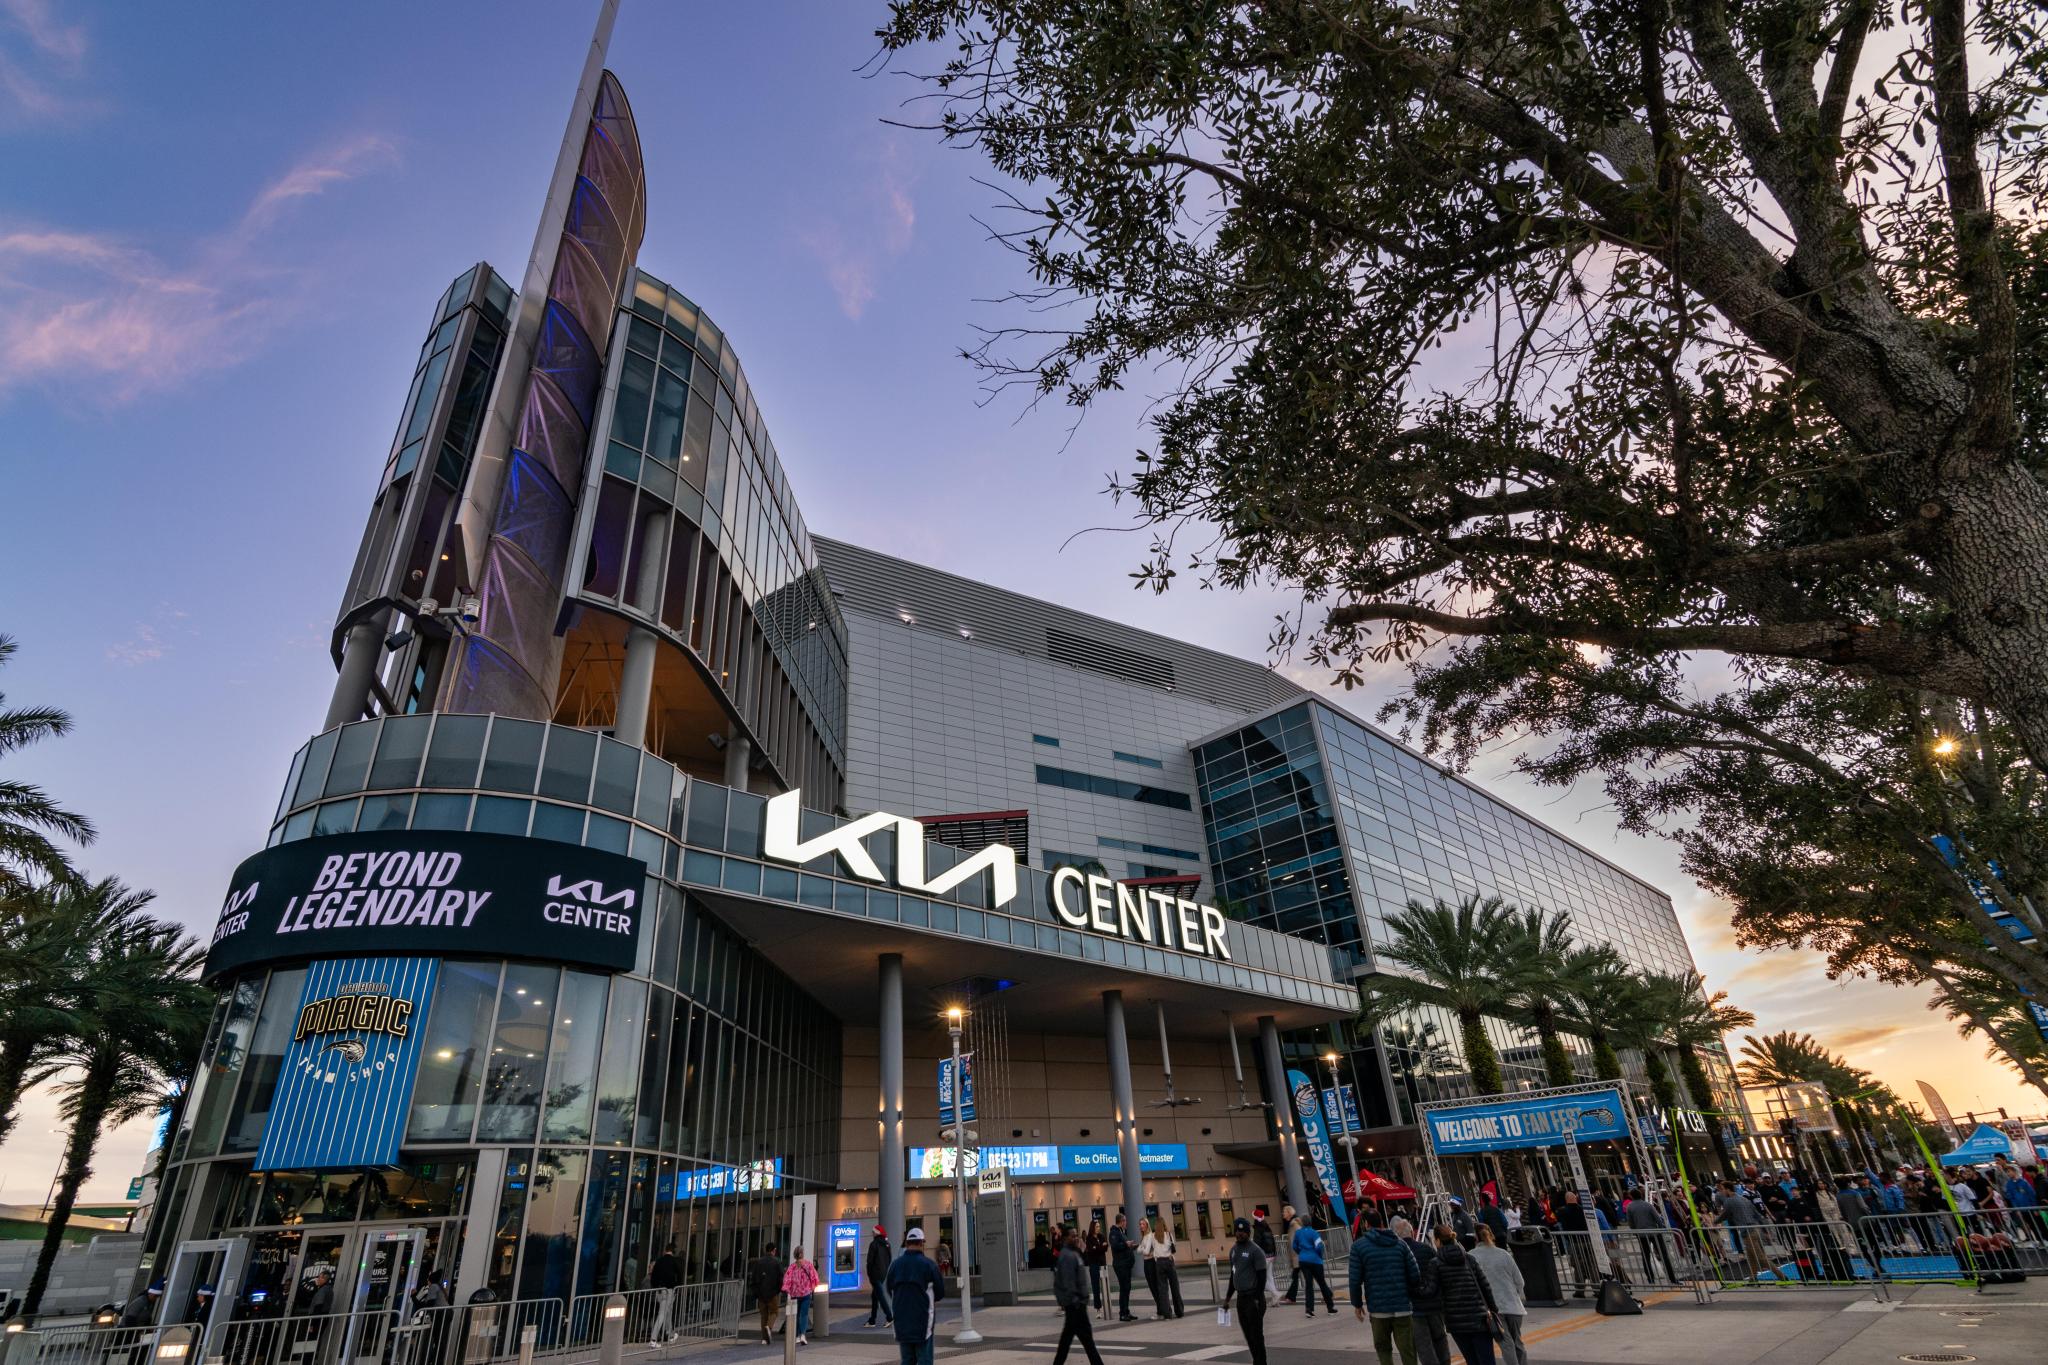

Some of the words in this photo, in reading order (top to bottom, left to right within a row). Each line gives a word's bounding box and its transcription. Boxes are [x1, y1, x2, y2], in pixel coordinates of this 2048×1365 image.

[312, 851, 462, 892] BEYOND
[764, 787, 1017, 909] KIA
[1052, 866, 1231, 960] CENTER
[547, 874, 635, 909] KIA
[276, 889, 493, 935] LEGENDARY
[543, 901, 631, 935] CENTER
[294, 994, 413, 1042] MAGIC
[298, 1056, 336, 1084] TEAM
[350, 1052, 396, 1082] SHOP
[943, 1063, 952, 1104] MAGIC
[1434, 1116, 1502, 1143] WELCOME
[1500, 1114, 1523, 1137] TO
[1522, 1111, 1552, 1136] FAN
[988, 1152, 1008, 1169] DEC
[1008, 1152, 1021, 1169] 23
[1025, 1152, 1031, 1168] 7
[1032, 1151, 1049, 1168] PM
[1074, 1154, 1091, 1164] Box
[1092, 1153, 1118, 1164] Office
[1139, 1153, 1174, 1163] ketmaster
[981, 1172, 1001, 1182] KIA
[982, 1181, 1001, 1190] CENTER
